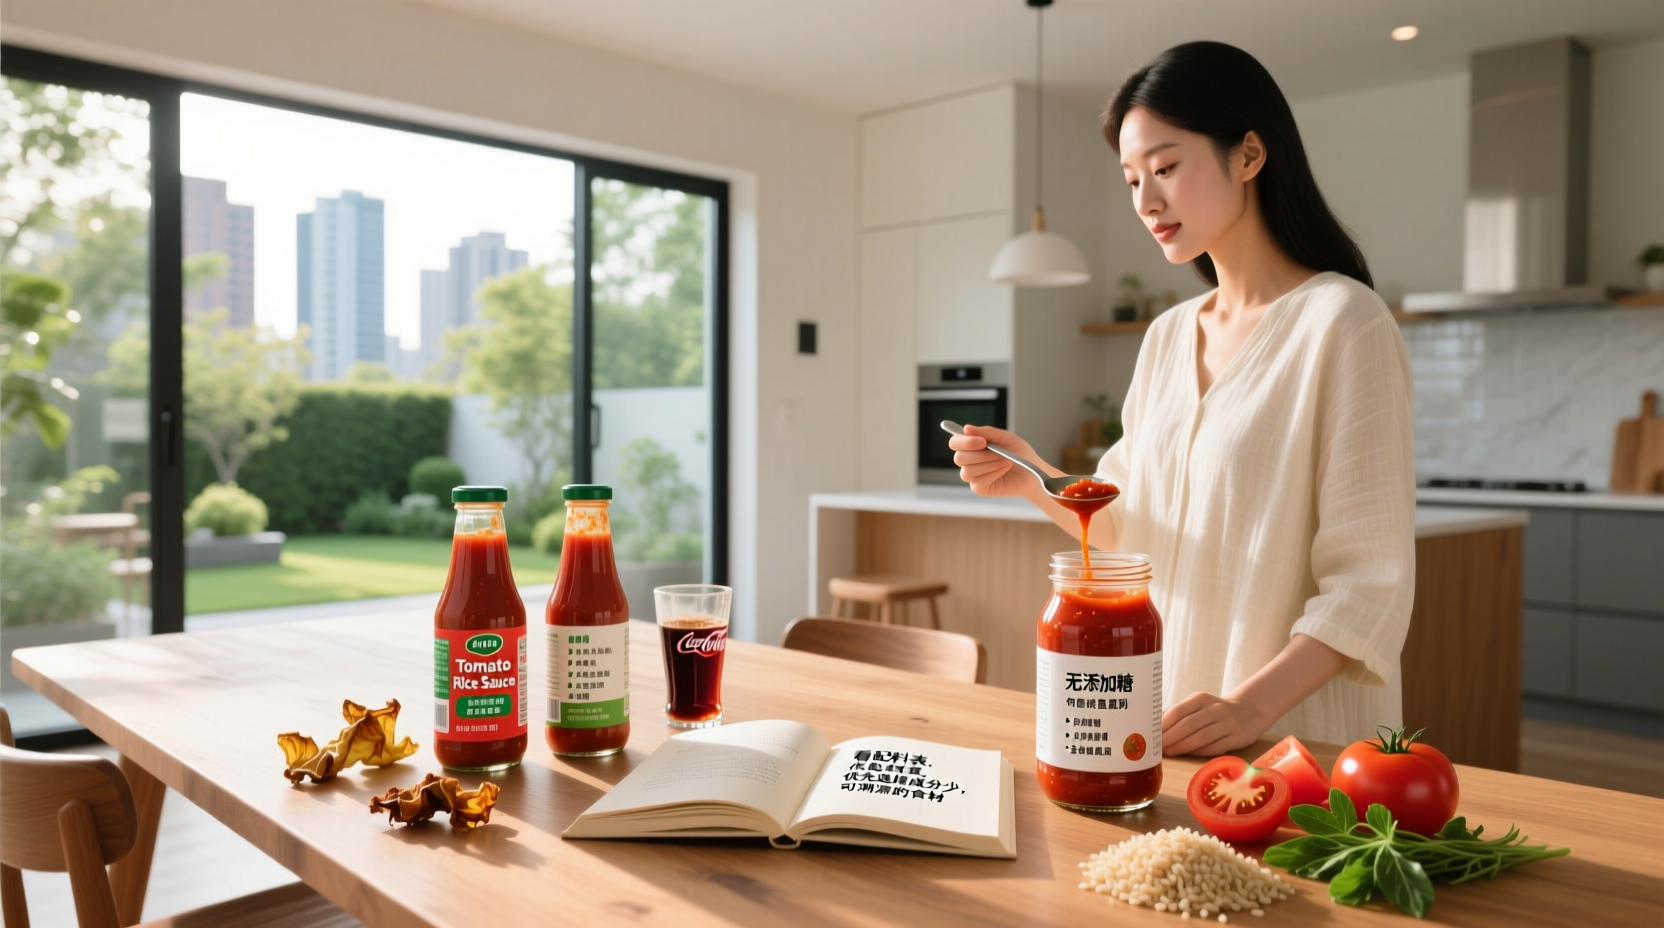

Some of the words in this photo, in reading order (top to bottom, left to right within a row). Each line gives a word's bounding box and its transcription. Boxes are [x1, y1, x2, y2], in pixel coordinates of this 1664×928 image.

[455, 658, 512, 673] Tomato
[1065, 672, 1134, 693] 无添加糖
